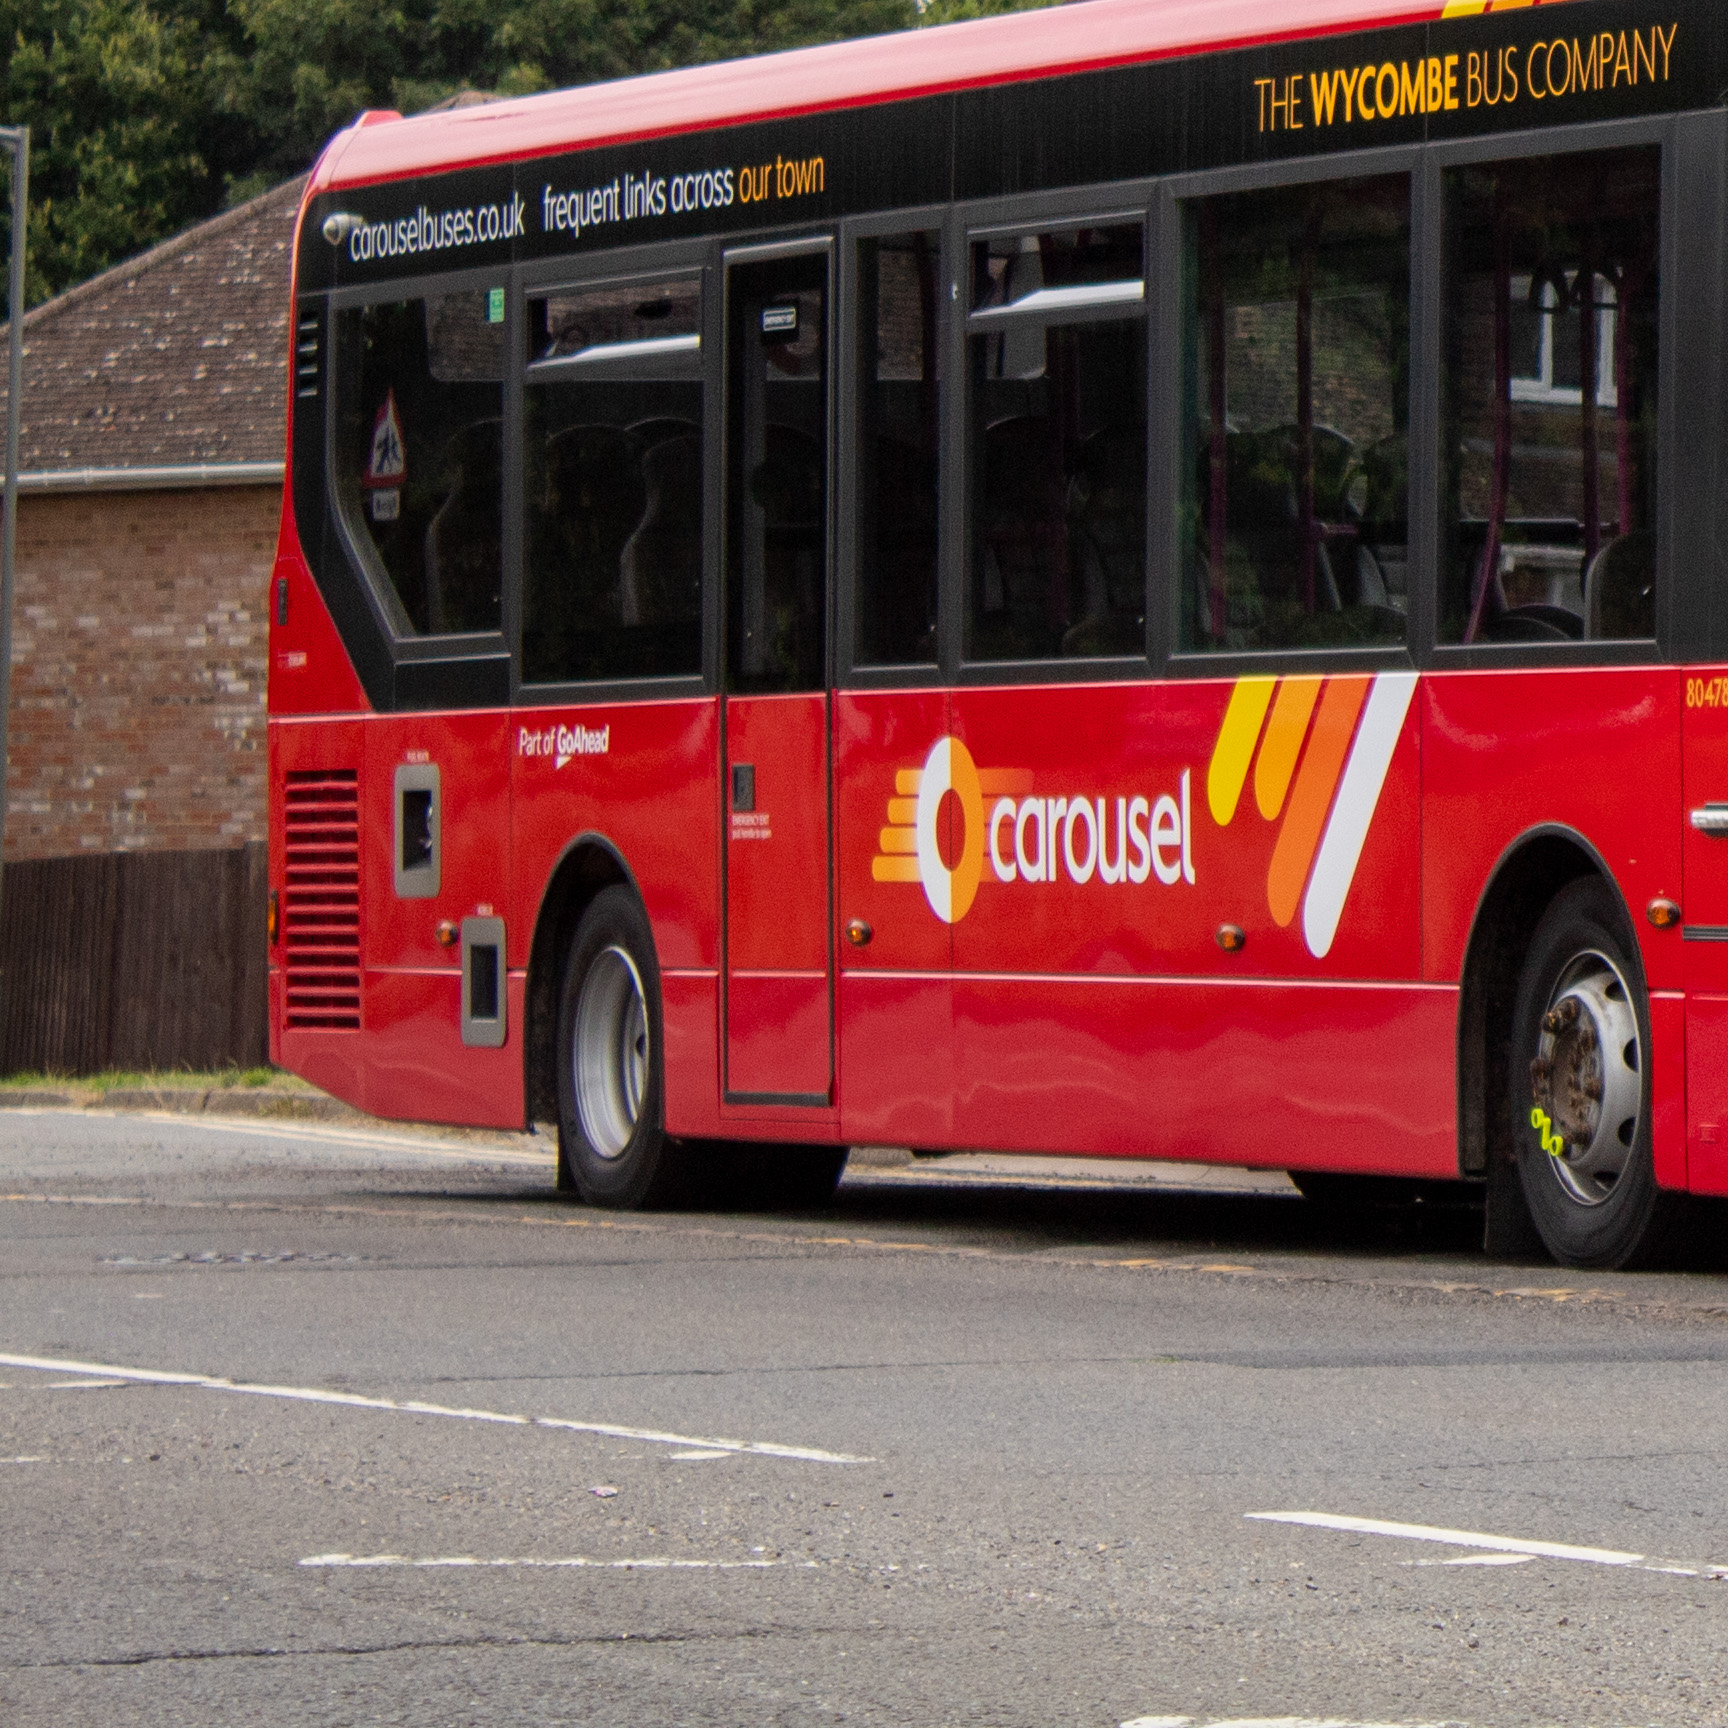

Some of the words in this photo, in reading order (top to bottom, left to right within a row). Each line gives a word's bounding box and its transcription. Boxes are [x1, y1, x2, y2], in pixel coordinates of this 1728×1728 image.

[1254, 75, 1303, 132] THE
[1310, 54, 1459, 126] WYCOMBE
[1467, 46, 1518, 108] BUS
[1527, 23, 1677, 99] COMPANY
[348, 193, 525, 261] carouselbuses.co.uk
[542, 181, 620, 238] frequent
[624, 171, 666, 221] links
[671, 168, 734, 212] across
[739, 163, 771, 203] our
[776, 155, 824, 198] town
[519, 726, 541, 756] Part
[543, 726, 556, 756] of
[557, 723, 610, 755] GoAhead
[990, 768, 1196, 885] carousel
